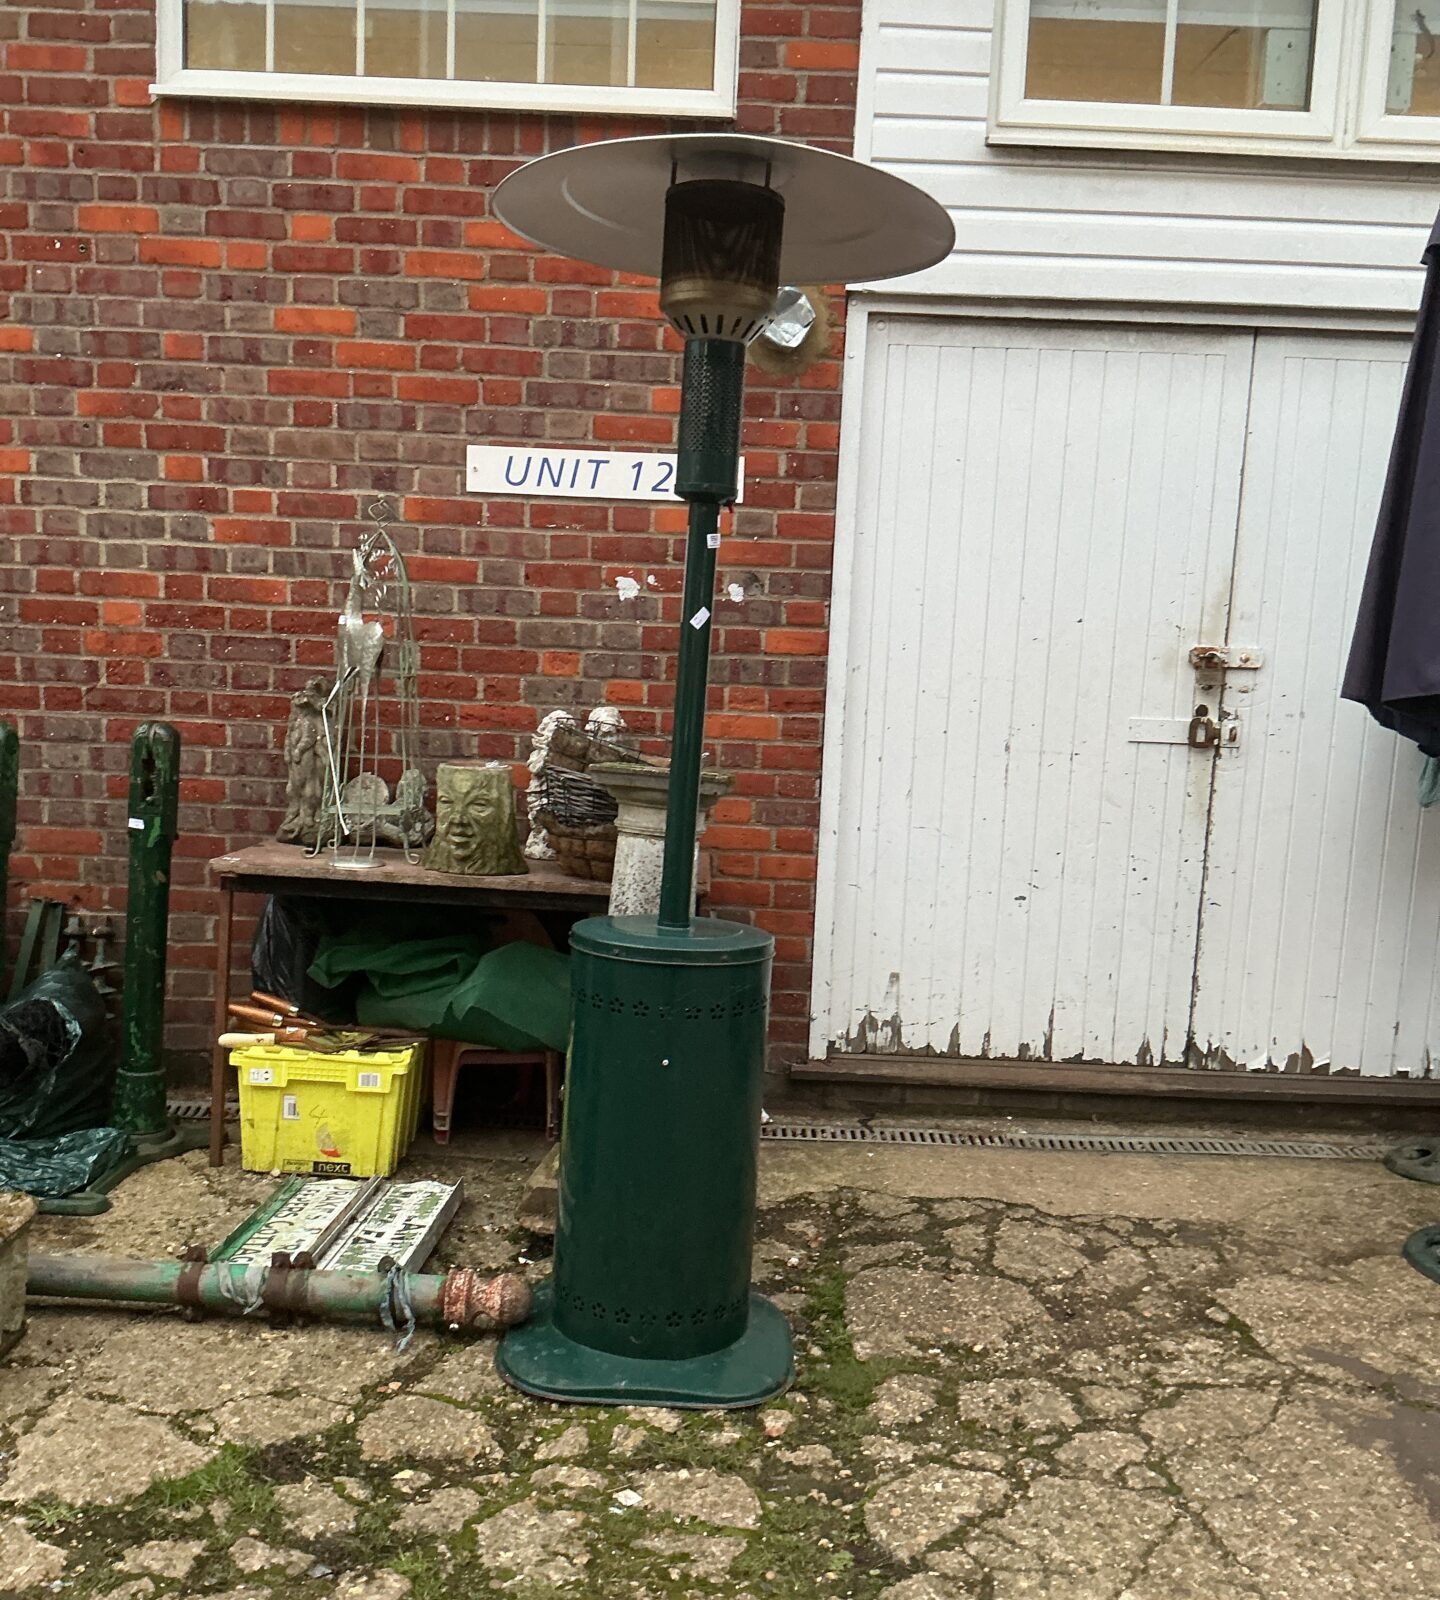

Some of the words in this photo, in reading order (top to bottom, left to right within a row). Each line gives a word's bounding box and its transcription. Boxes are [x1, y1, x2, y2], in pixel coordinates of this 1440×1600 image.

[504, 455, 610, 489] UNIT
[631, 461, 674, 493] 12
[276, 1186, 322, 1219] EEPERS
[228, 1220, 295, 1264] COTTAG
